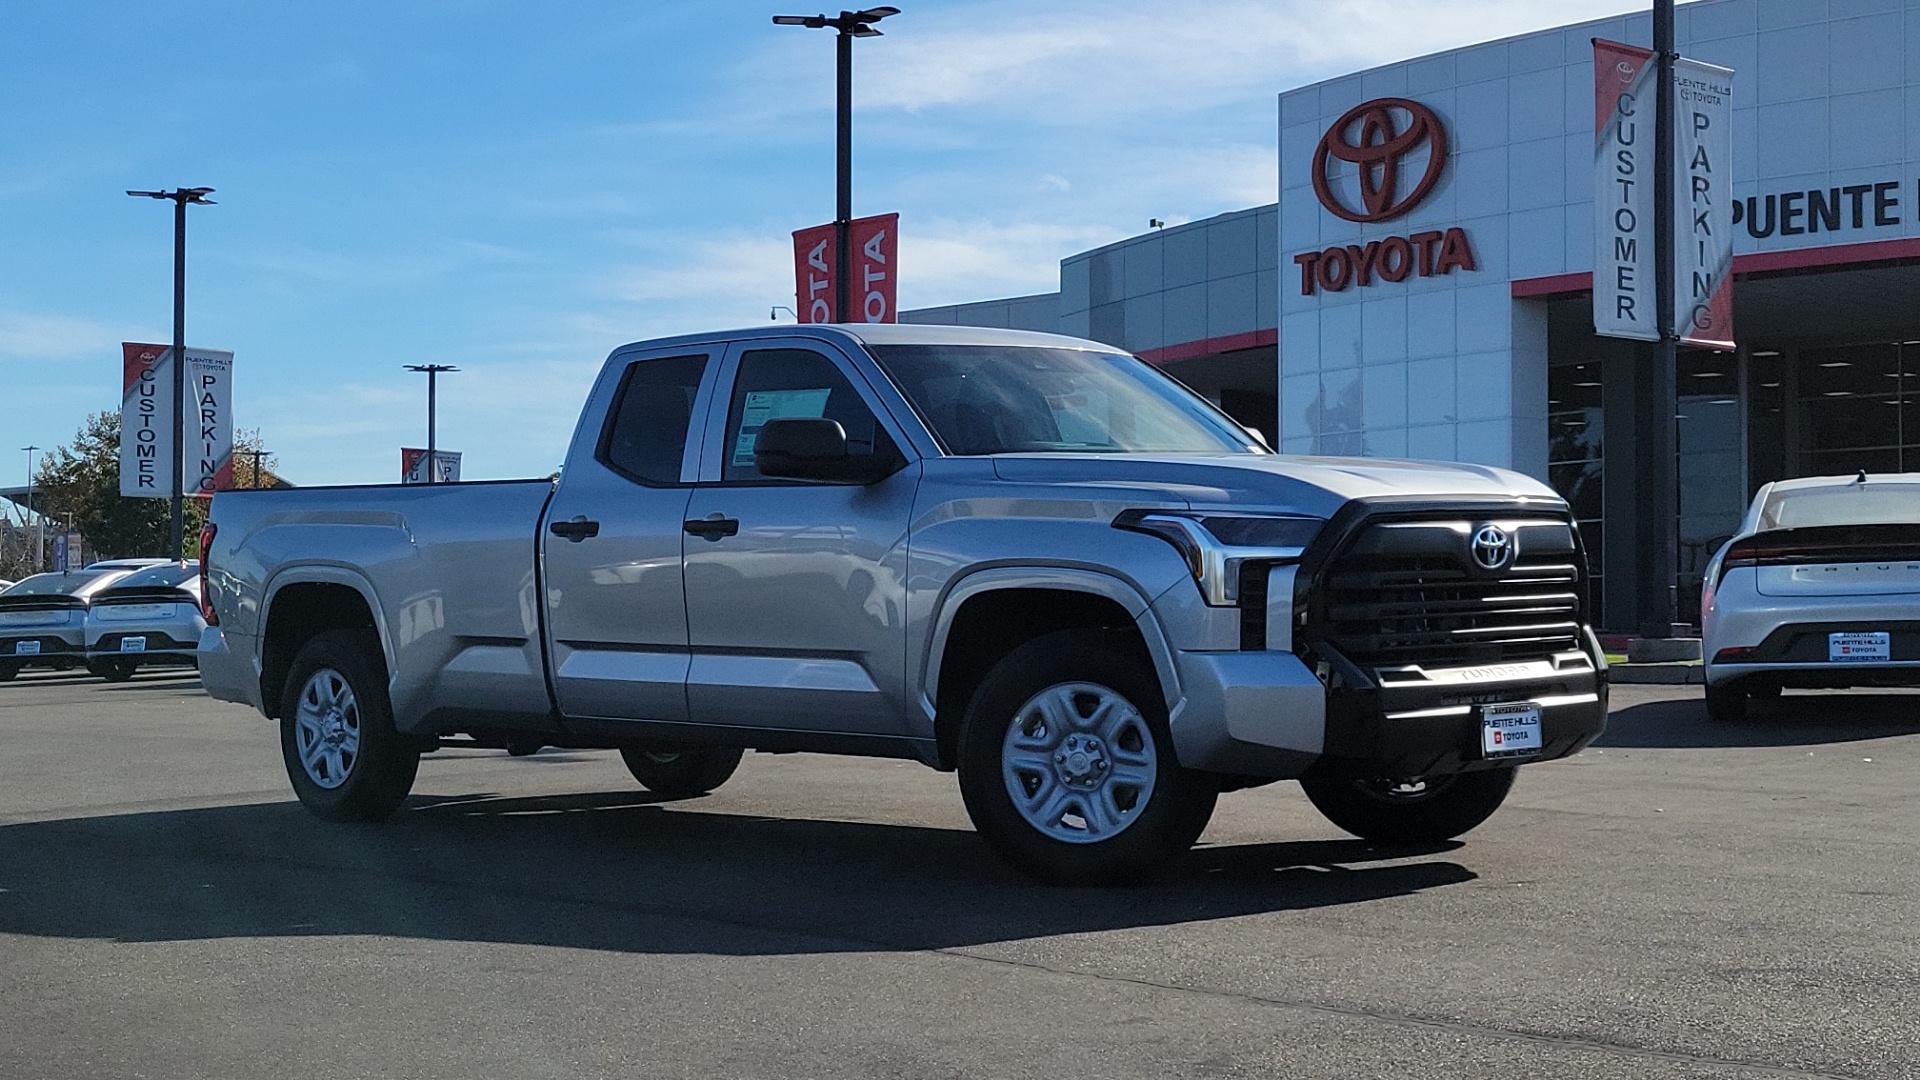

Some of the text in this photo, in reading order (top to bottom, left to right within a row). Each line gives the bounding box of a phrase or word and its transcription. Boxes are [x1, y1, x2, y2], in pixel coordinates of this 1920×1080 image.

[1693, 91, 1721, 106] TOYOTA
[1614, 92, 1637, 322] CUSTOMER
[1690, 112, 1712, 331] PARKING
[1294, 227, 1476, 296] TOYOTA
[137, 369, 156, 488] CUSTOMER
[200, 375, 217, 491] PARKING
[1460, 665, 1533, 681] TUNDRA
[1503, 731, 1529, 741] TOYOTA
